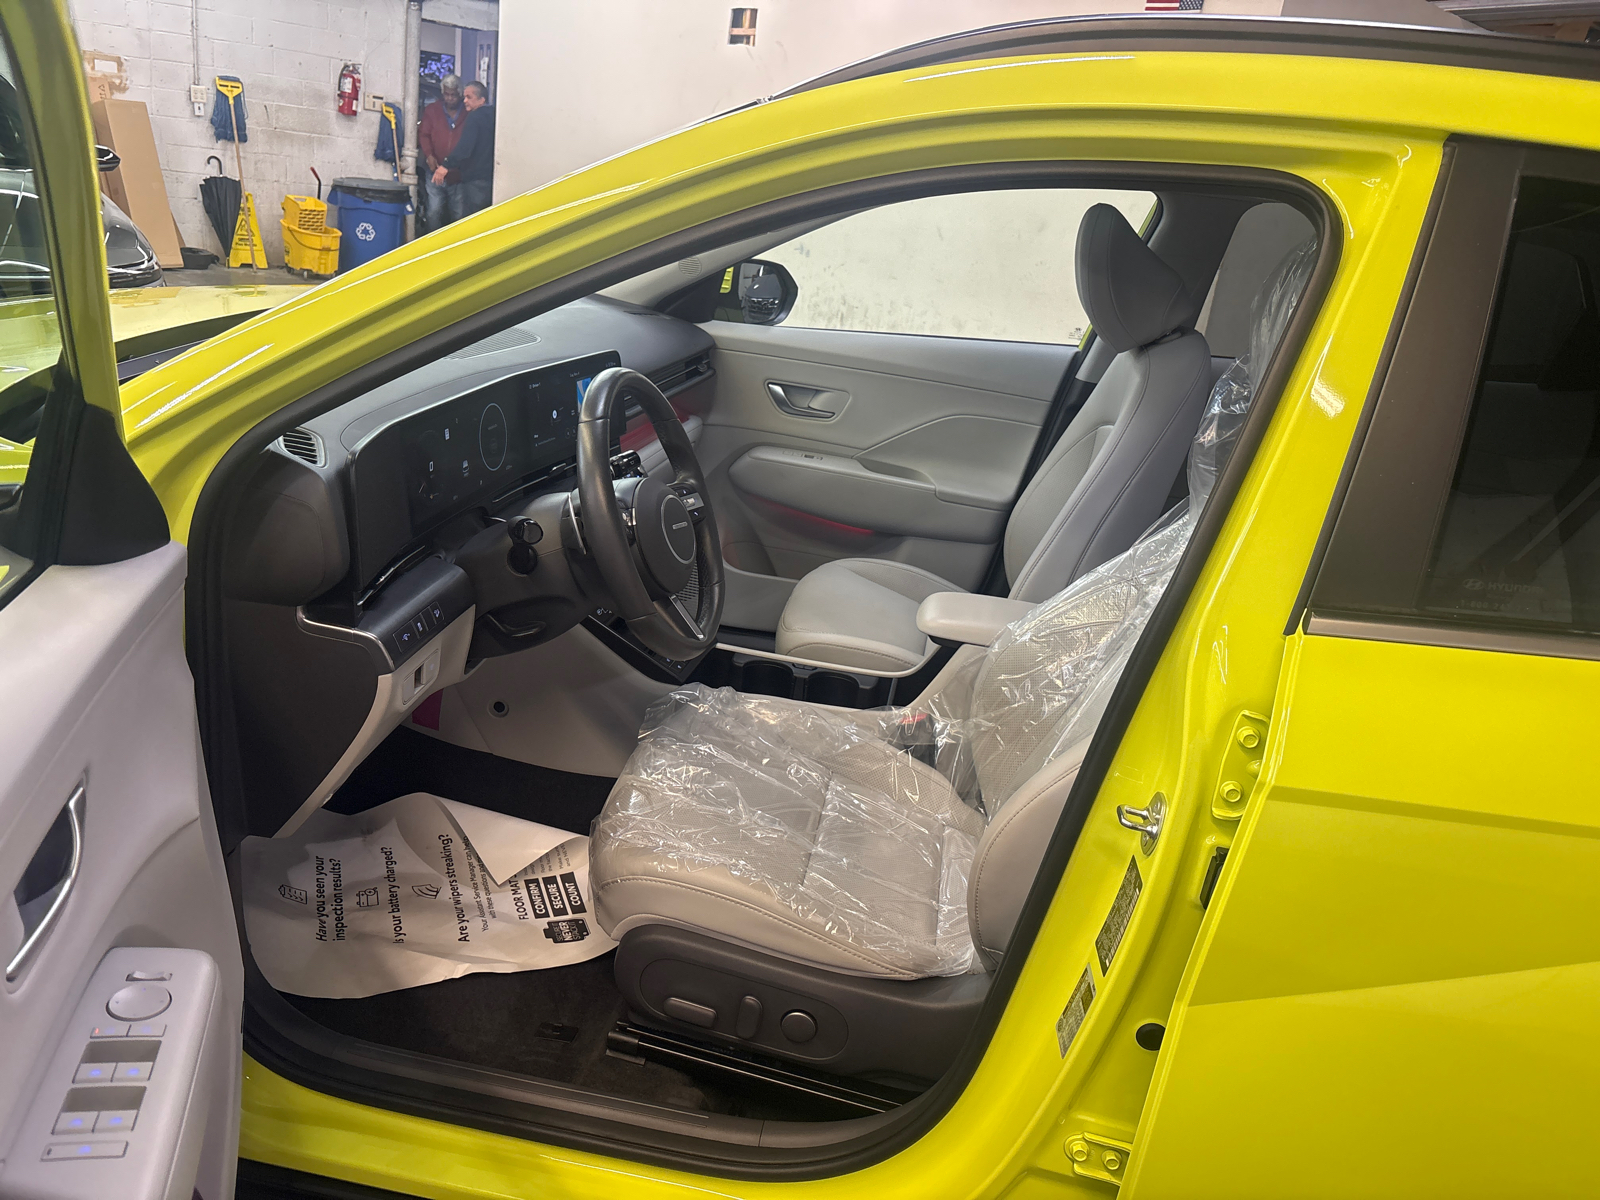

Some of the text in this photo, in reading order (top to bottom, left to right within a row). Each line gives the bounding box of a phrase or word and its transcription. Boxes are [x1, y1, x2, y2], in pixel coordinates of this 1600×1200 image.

[462, 836, 470, 851] help
[380, 847, 397, 883] charged?
[467, 861, 477, 882] Manager
[476, 864, 485, 873] and
[438, 833, 470, 943] Are your wipers streaking?
[471, 882, 481, 900] Service
[480, 873, 491, 896] questions
[508, 879, 522, 896] MAT
[565, 882, 581, 906] COUNT
[315, 856, 329, 942] Have you seen your
[329, 858, 348, 941] inspection results?
[388, 884, 400, 914] battery
[513, 896, 530, 920] FLOOR
[528, 883, 546, 914] CONFIRM
[547, 883, 564, 910] SECURE
[474, 900, 486, 918] Assistant
[489, 909, 497, 920] with
[392, 915, 407, 938] your
[481, 918, 489, 932] Your
[553, 926, 562, 942] SECURE
[558, 922, 572, 941] NEVER
